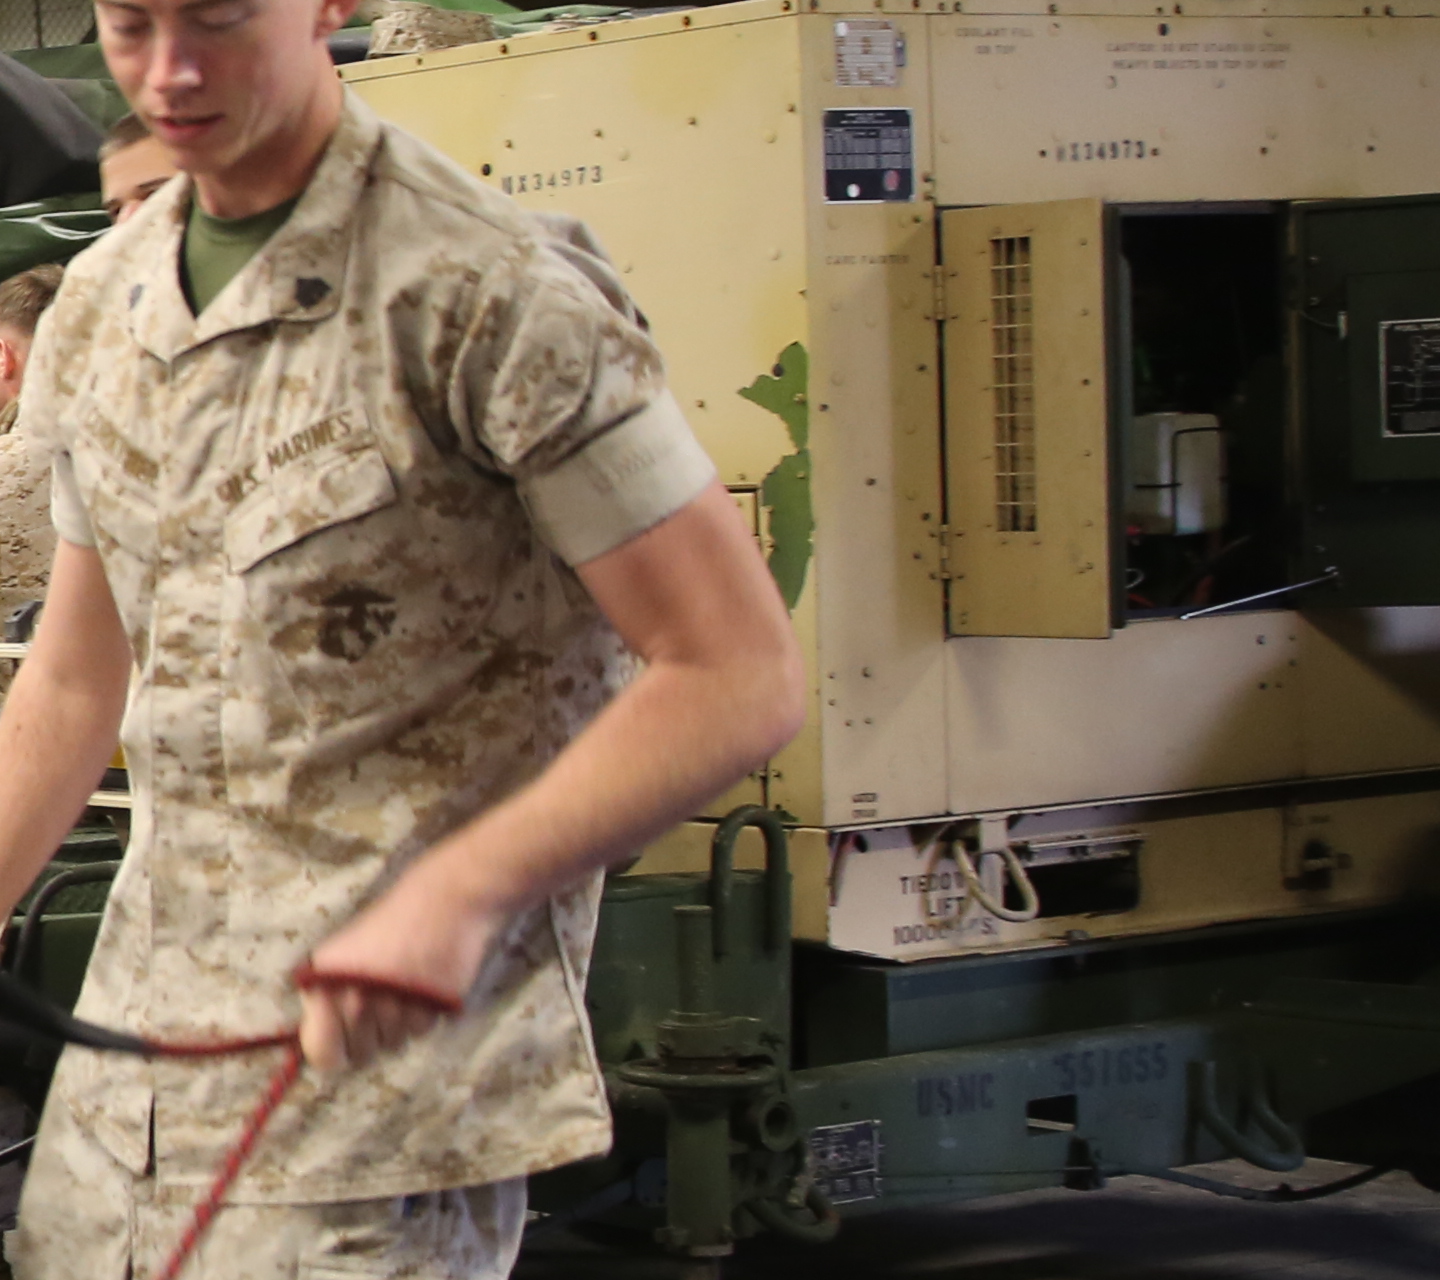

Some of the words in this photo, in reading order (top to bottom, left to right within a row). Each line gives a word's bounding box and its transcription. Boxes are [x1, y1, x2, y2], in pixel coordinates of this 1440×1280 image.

[267, 410, 353, 473] MARINES
[899, 871, 968, 894] TIEDOW
[927, 896, 964, 916] LIFT
[918, 1073, 995, 1117] USMC
